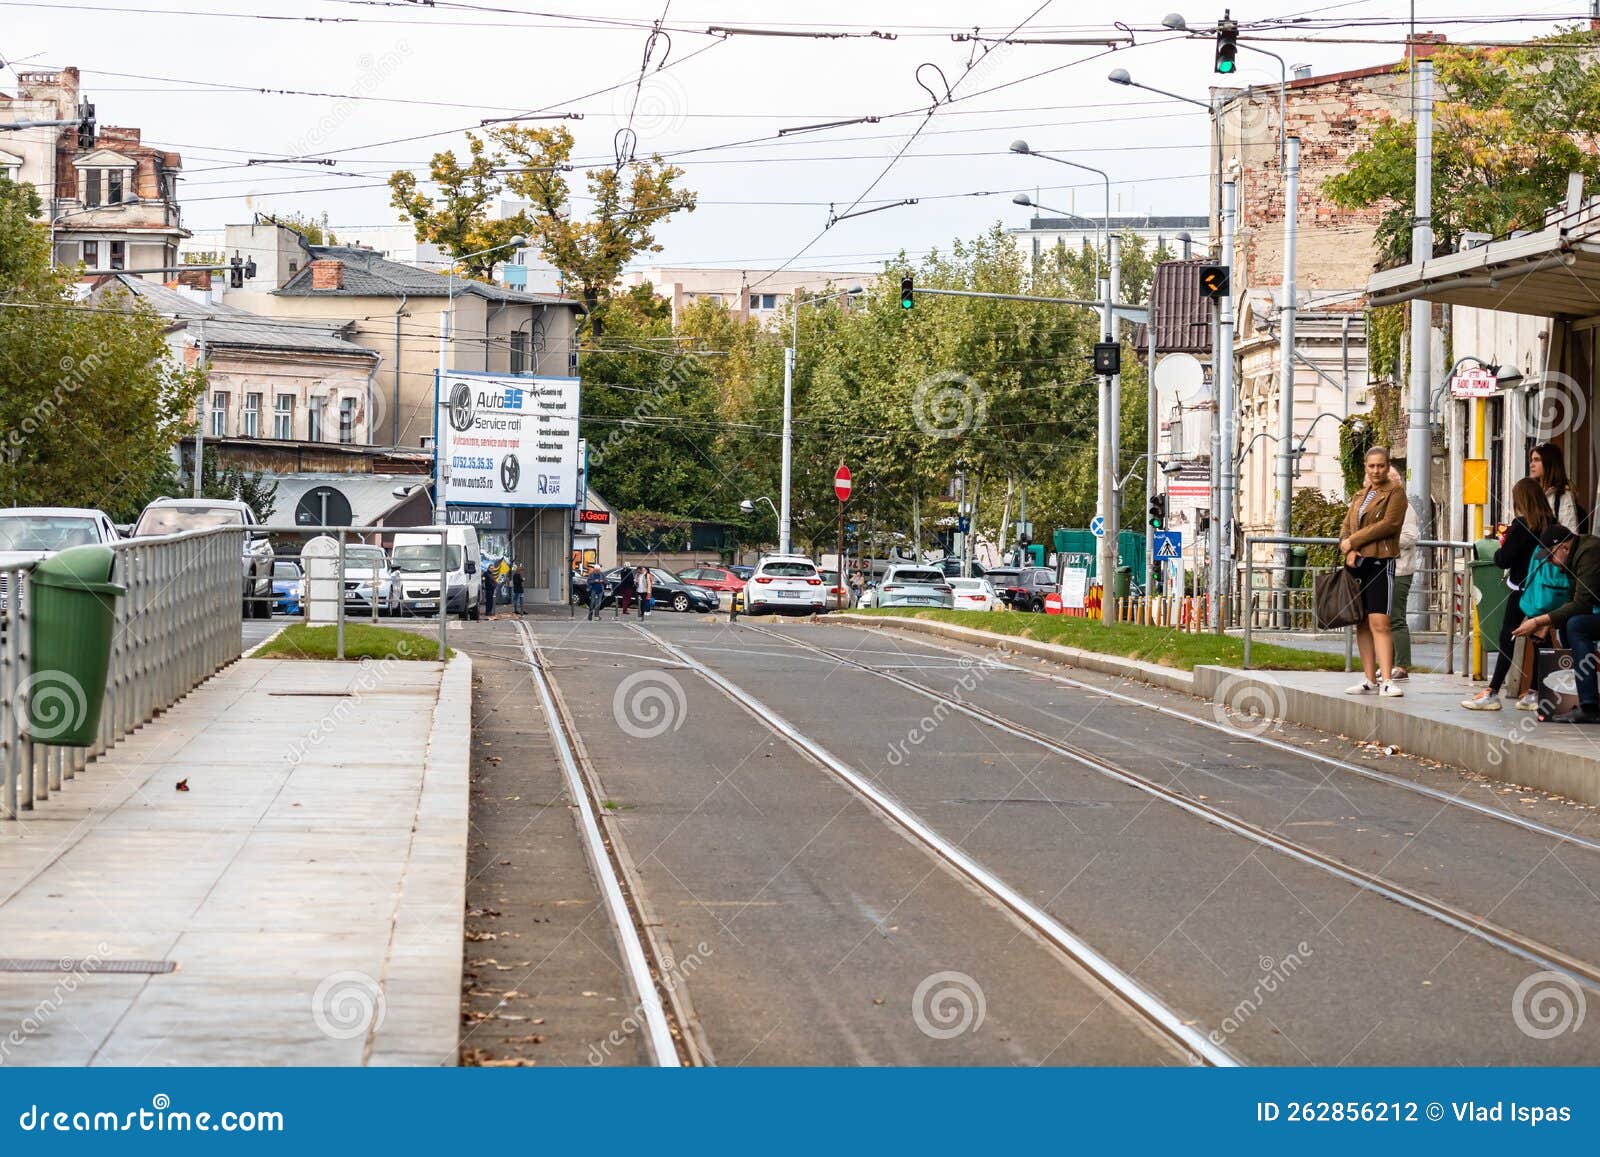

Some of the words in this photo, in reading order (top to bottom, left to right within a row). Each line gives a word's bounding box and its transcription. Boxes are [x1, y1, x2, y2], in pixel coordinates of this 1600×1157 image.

[475, 417, 507, 430] Service
[452, 456, 493, 470] 0752.35.35.35
[452, 476, 493, 489] www.auto35.ro
[450, 510, 493, 524] VULCANIZARE
